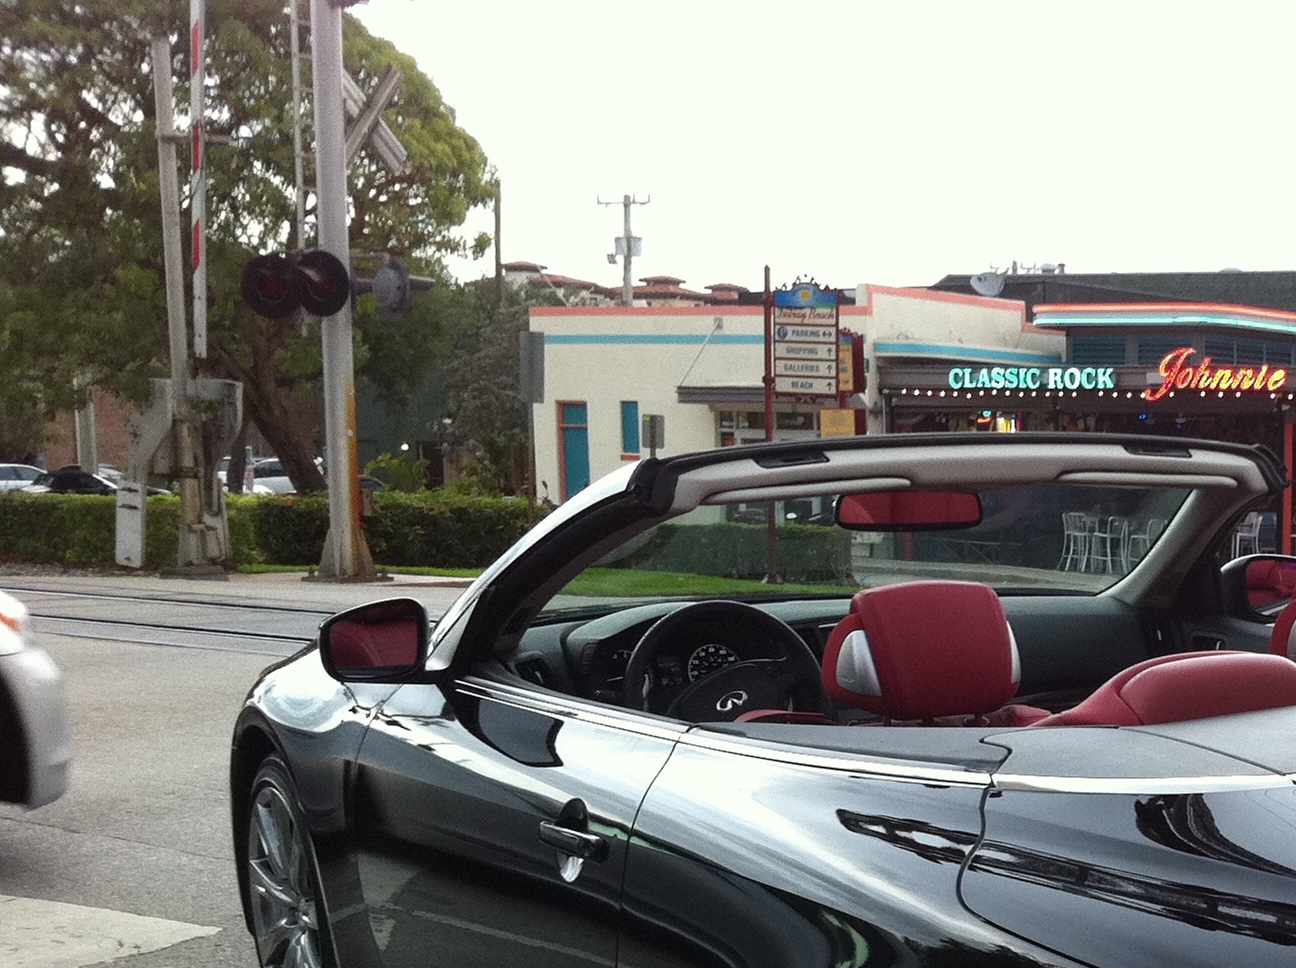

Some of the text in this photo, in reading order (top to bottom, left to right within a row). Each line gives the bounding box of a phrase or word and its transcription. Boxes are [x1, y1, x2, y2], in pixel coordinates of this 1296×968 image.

[791, 329, 820, 337] PARKING
[783, 363, 820, 373] GALLERIES
[948, 367, 1115, 390] CLASSIC ROCK
[1145, 347, 1288, 401] Johnnie
[791, 380, 814, 390] BEACH
